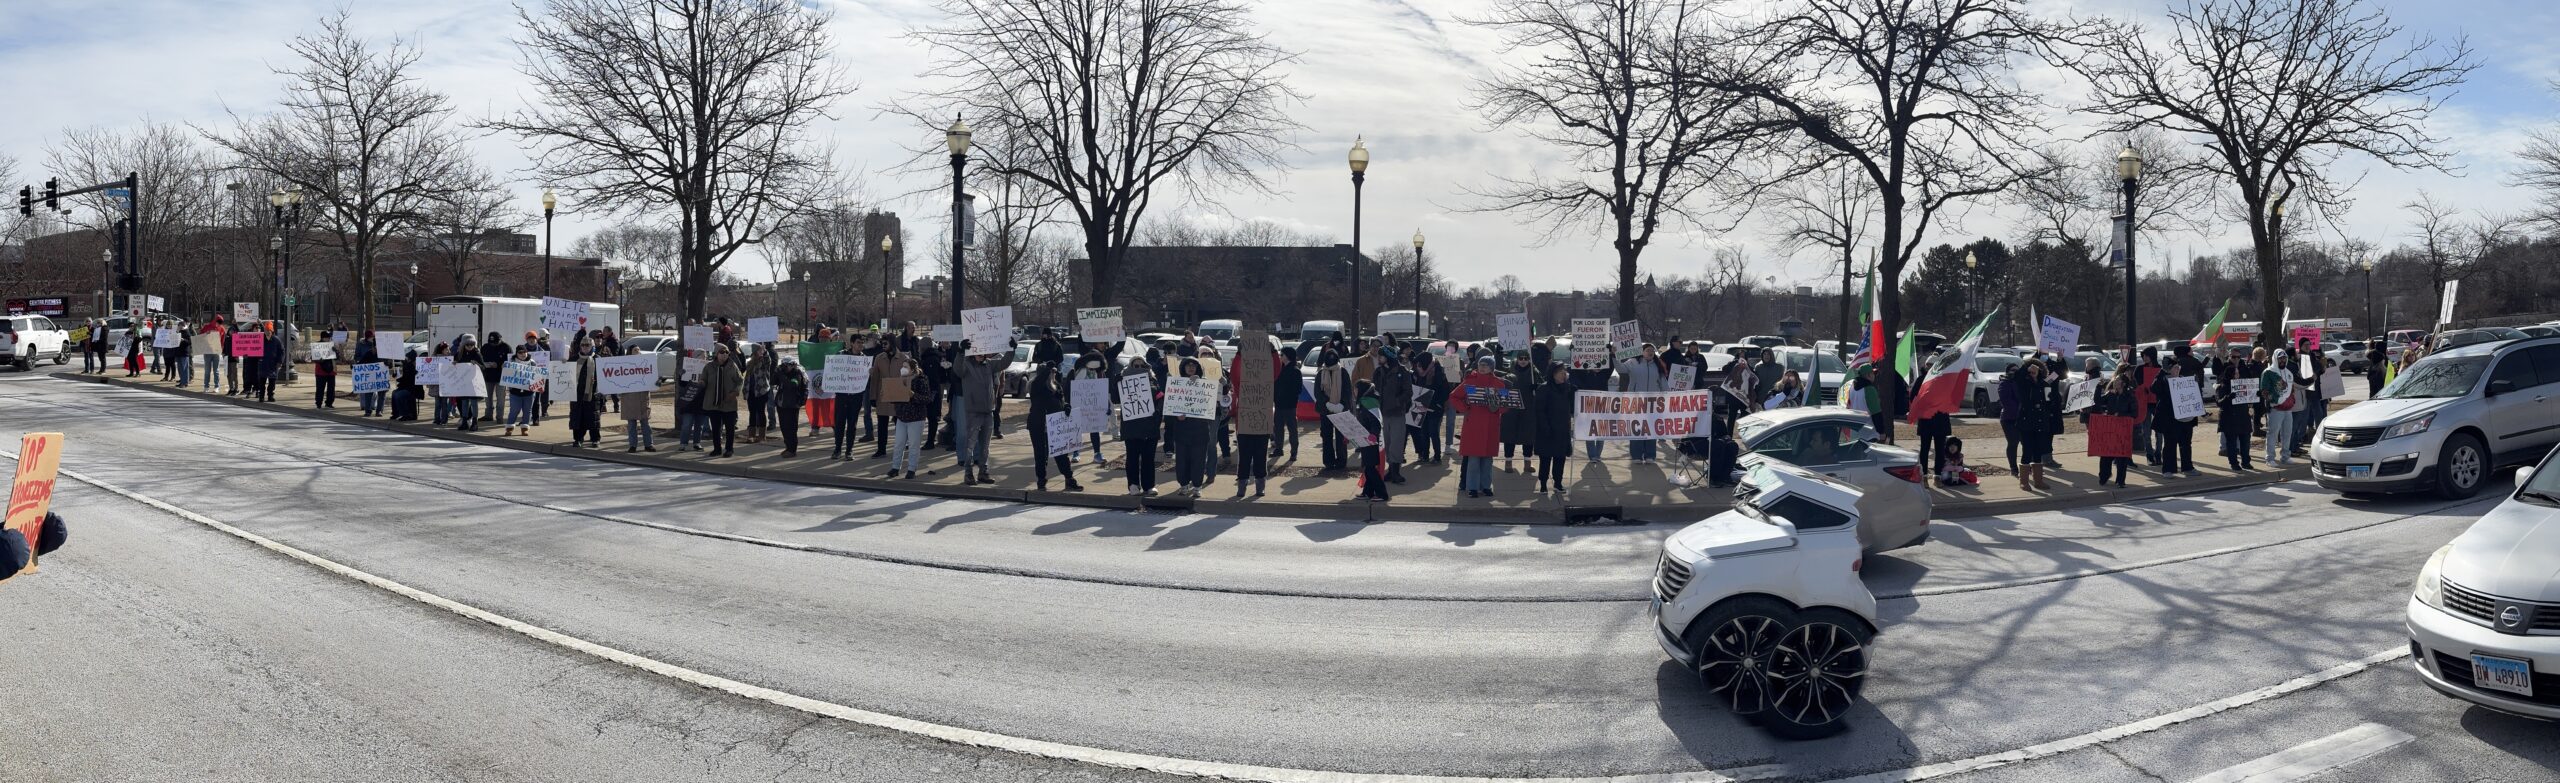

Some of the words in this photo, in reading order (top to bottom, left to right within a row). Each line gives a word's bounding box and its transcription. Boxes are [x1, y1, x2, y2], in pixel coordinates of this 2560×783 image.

[545, 298, 587, 313] UNITE
[546, 309, 579, 320] against
[548, 319, 579, 331] HATE
[1613, 322, 1637, 337] FIGHT
[1620, 339, 1635, 349] NOT
[353, 363, 381, 373] HANDS
[602, 365, 653, 377] Welcome!
[354, 373, 371, 382] OFF
[375, 370, 389, 381] MY
[1120, 375, 1149, 395] HERE
[1185, 380, 1200, 388] ARE
[1201, 382, 1216, 390] AND
[1167, 387, 1193, 396] ALWAYS
[1194, 390, 1213, 398] WILL
[1184, 395, 1210, 404] NATION
[1580, 396, 1666, 414] IMMIGRANTS
[1669, 394, 1708, 412] MAKE
[1123, 399, 1151, 418] STAY
[1589, 419, 1651, 437] AMERICA
[1654, 416, 1698, 436] GREAT
[2495, 667, 2529, 688] 48910
